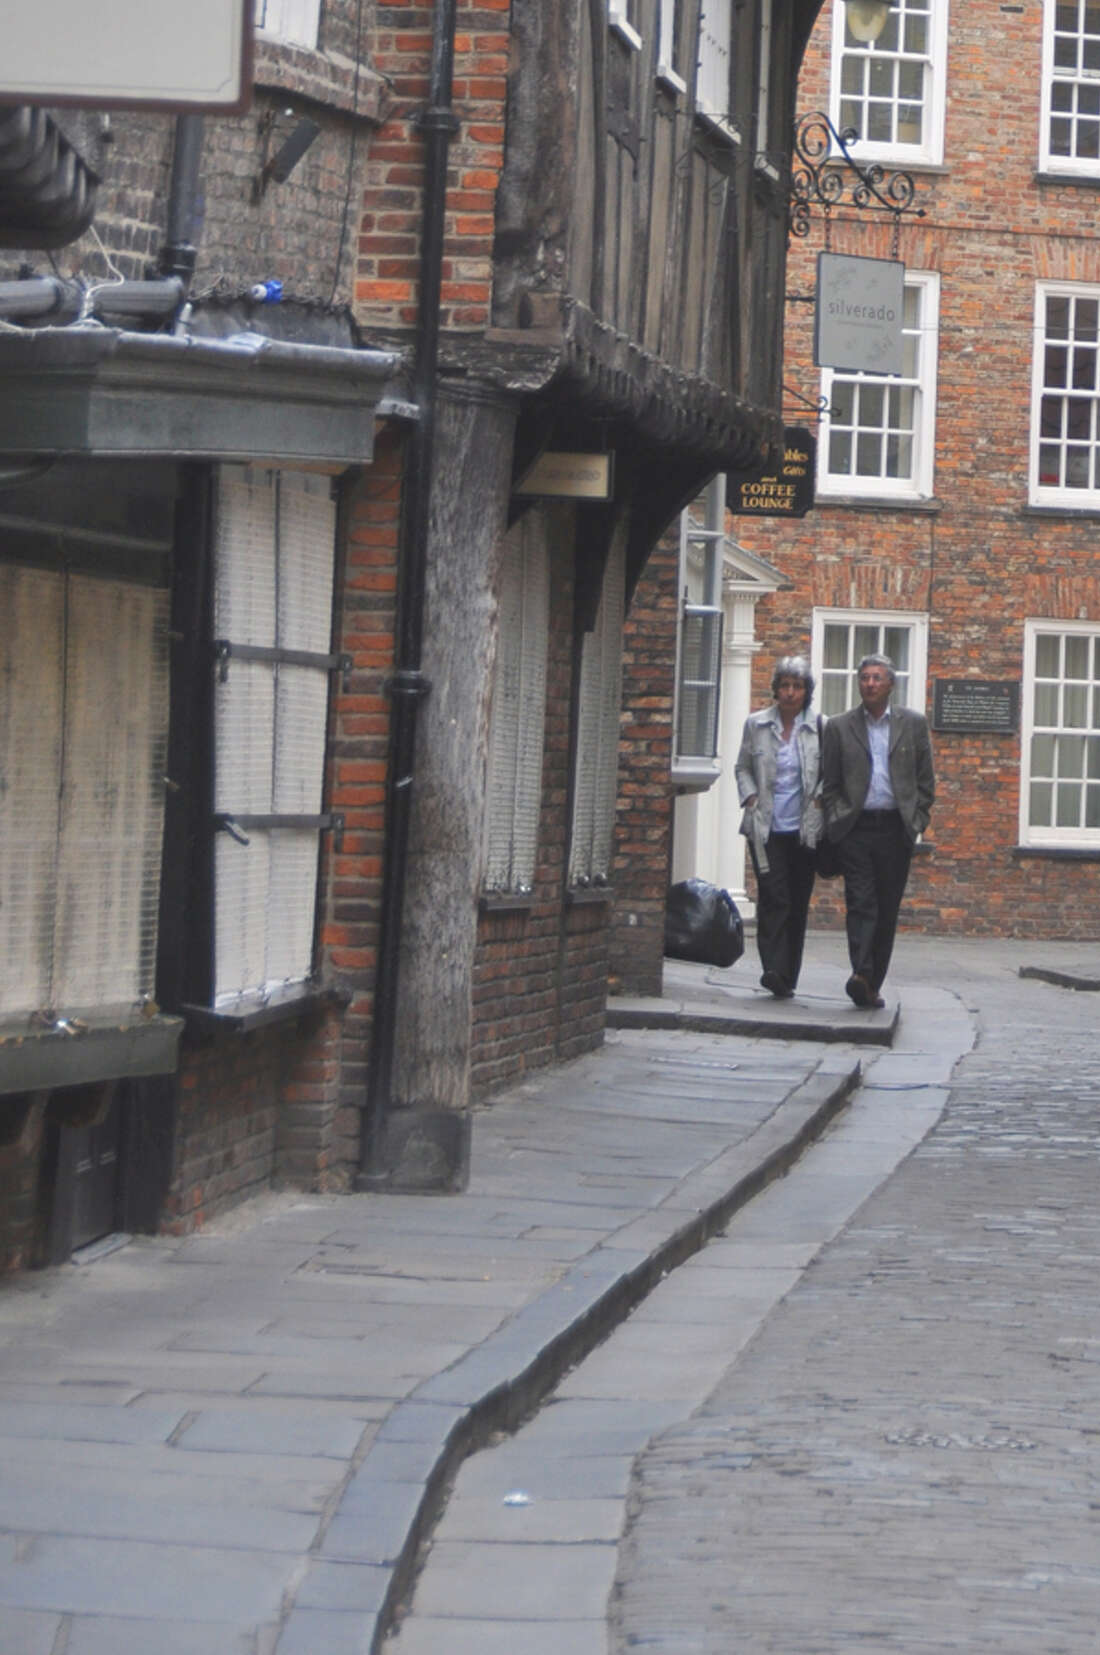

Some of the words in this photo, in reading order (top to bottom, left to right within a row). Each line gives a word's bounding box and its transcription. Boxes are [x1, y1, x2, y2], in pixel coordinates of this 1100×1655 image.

[828, 300, 895, 322] silverado
[741, 483, 796, 497] COFFEE
[742, 496, 794, 510] LOUNGE
